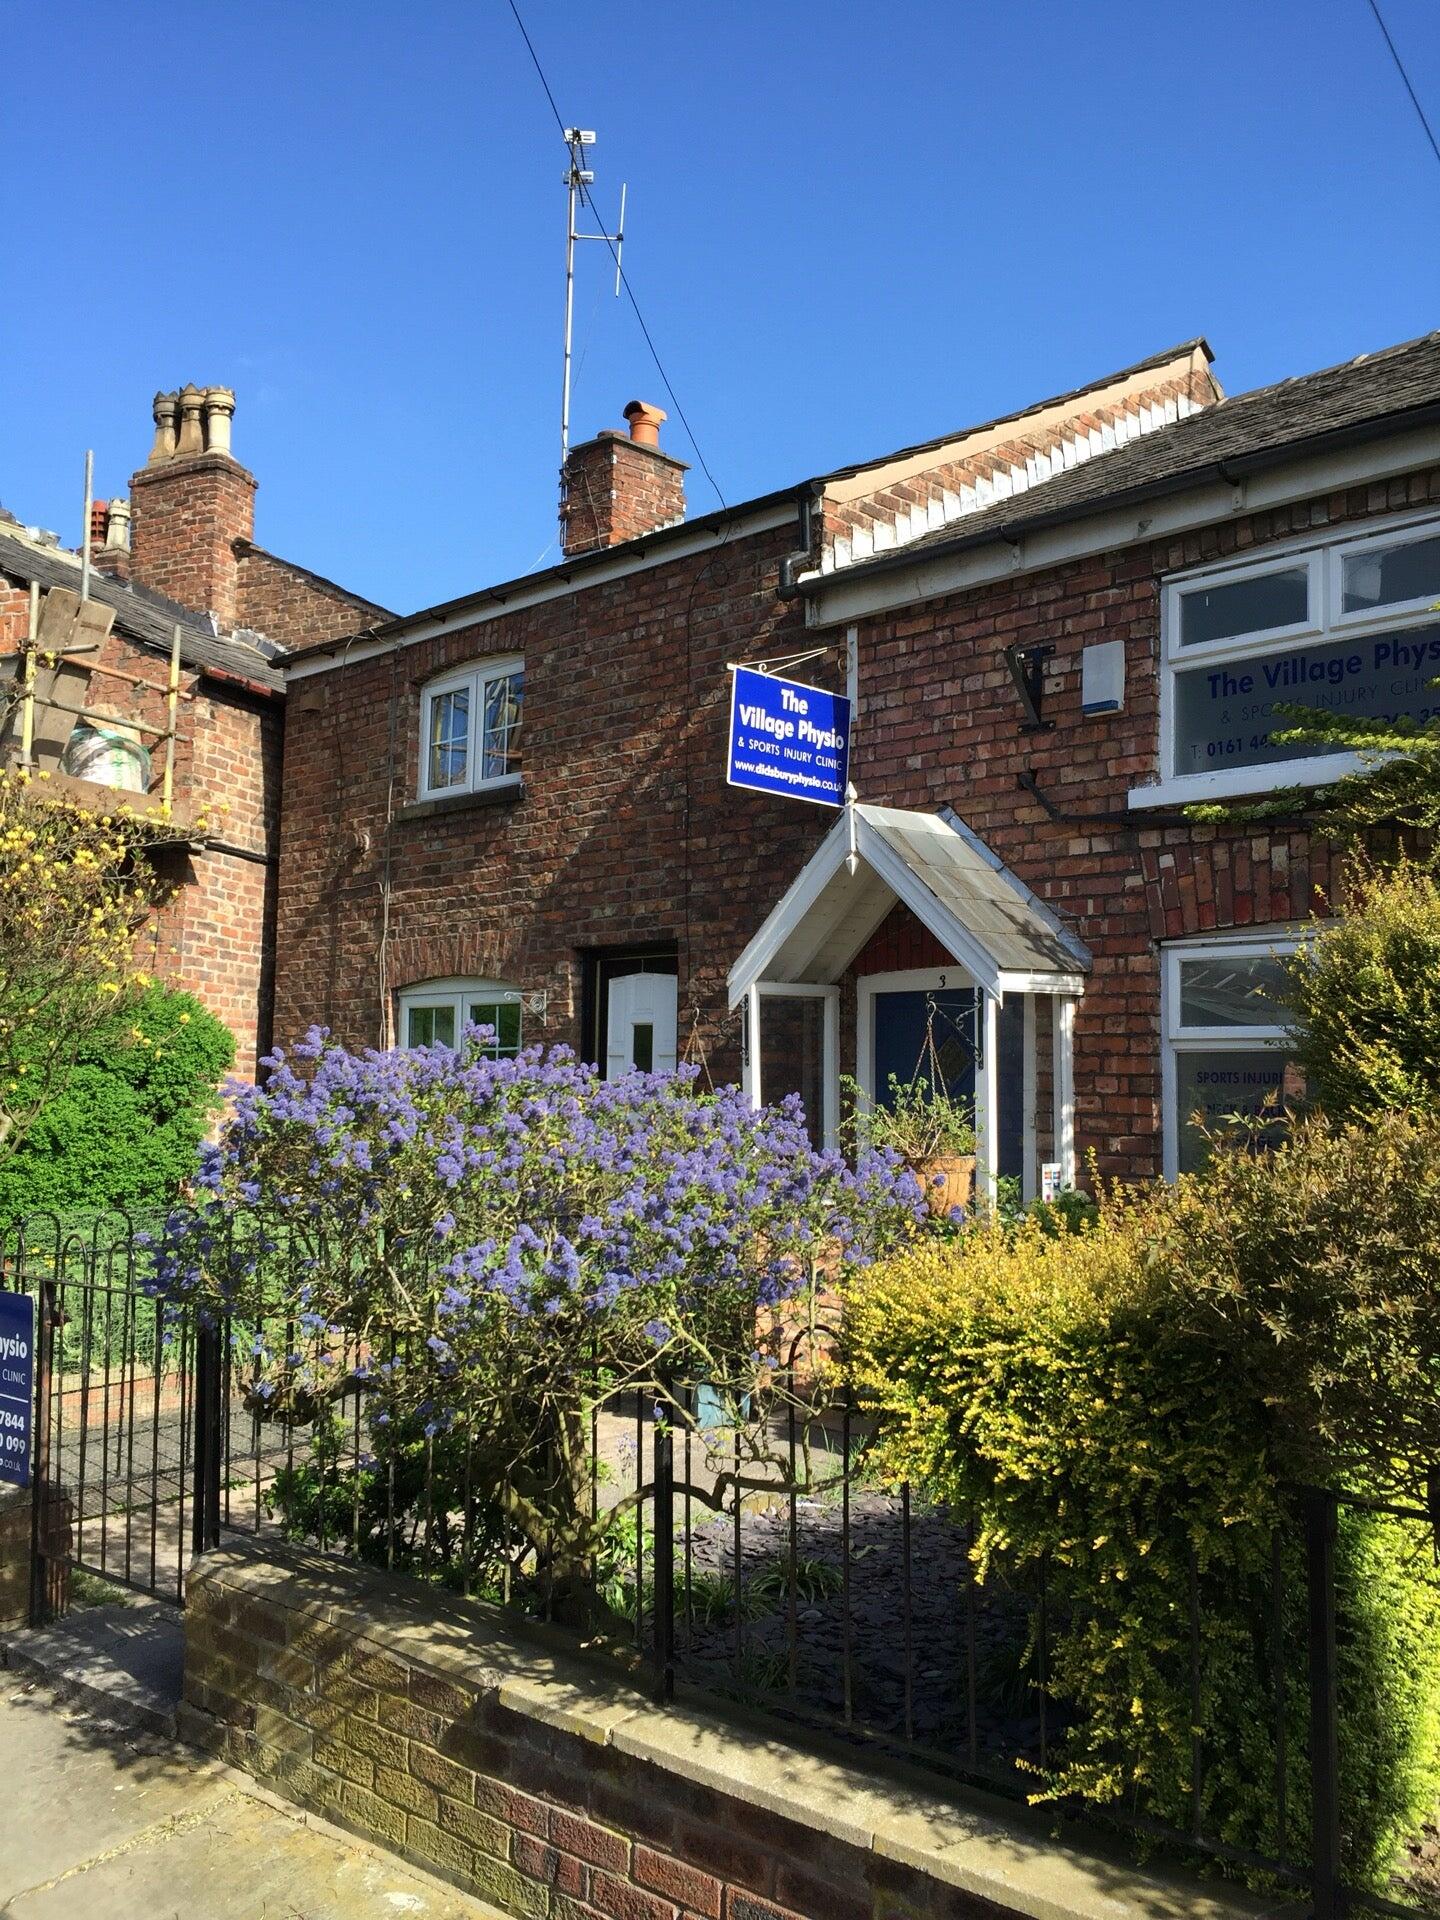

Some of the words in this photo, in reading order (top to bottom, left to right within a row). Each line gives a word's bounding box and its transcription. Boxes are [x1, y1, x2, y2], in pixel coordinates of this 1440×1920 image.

[1207, 671, 1254, 699] The
[1262, 655, 1363, 690] Village
[1374, 639, 1440, 671] Phys
[780, 688, 809, 715] The
[1219, 709, 1232, 725] &
[1315, 684, 1378, 708] INJURY
[739, 704, 795, 740] Village
[798, 719, 845, 750] Physio
[737, 736, 745, 748] &
[748, 738, 781, 756] SPORTS
[784, 747, 813, 764] INJURY
[815, 755, 843, 771] CLINIC
[1206, 737, 1243, 757] 0161
[734, 759, 843, 792] www.didsburyphysio.co.uk
[938, 975, 946, 988] 3
[1196, 1071, 1240, 1085] SPORTS
[2, 1368, 26, 1385] CLINIC
[6, 1435, 26, 1455] 099
